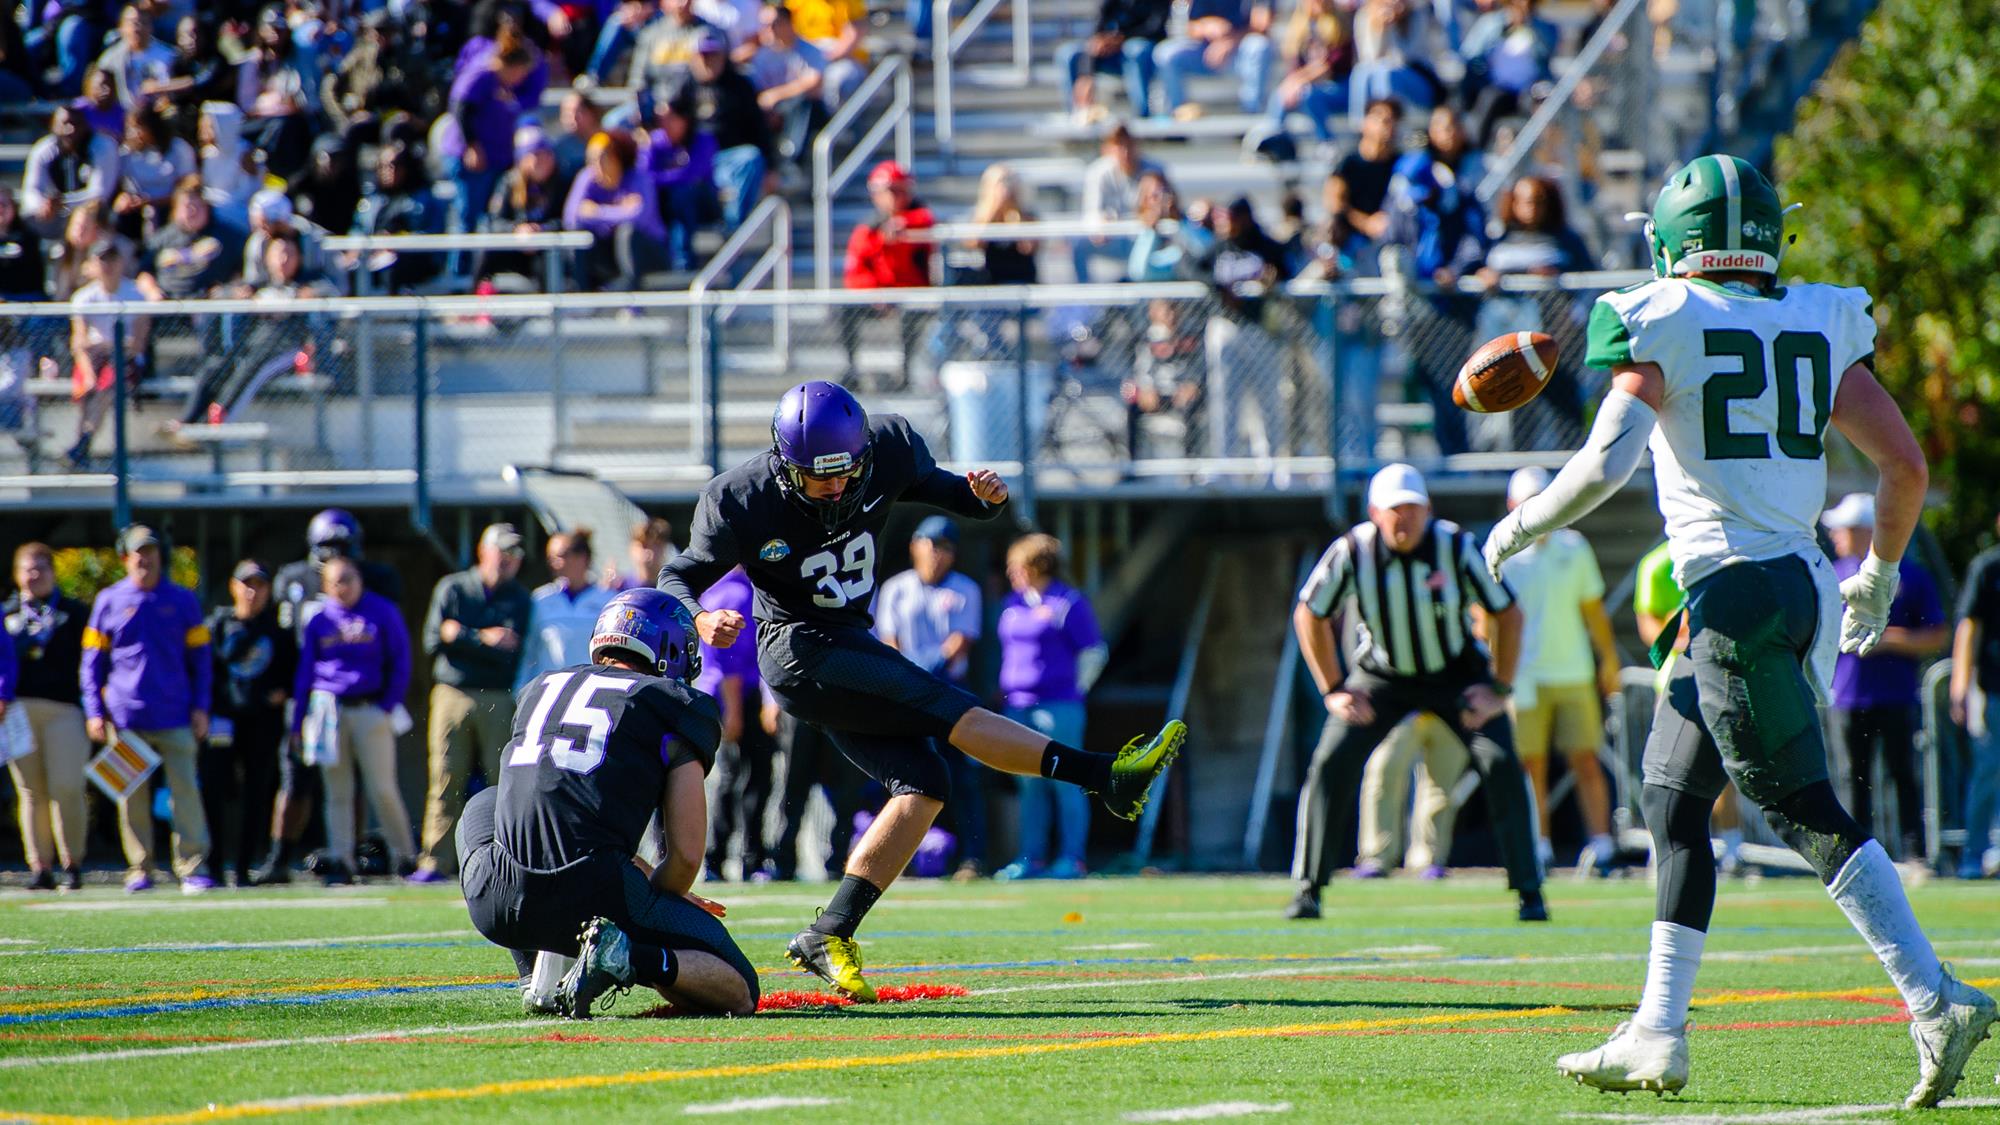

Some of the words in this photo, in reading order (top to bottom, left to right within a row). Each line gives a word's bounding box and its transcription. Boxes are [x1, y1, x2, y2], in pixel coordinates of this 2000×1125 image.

[1702, 255, 1764, 268] Riddell
[1703, 328, 1832, 460] 20
[801, 531, 876, 608] 39
[593, 635, 628, 647] Riddell
[508, 671, 639, 775] 15
